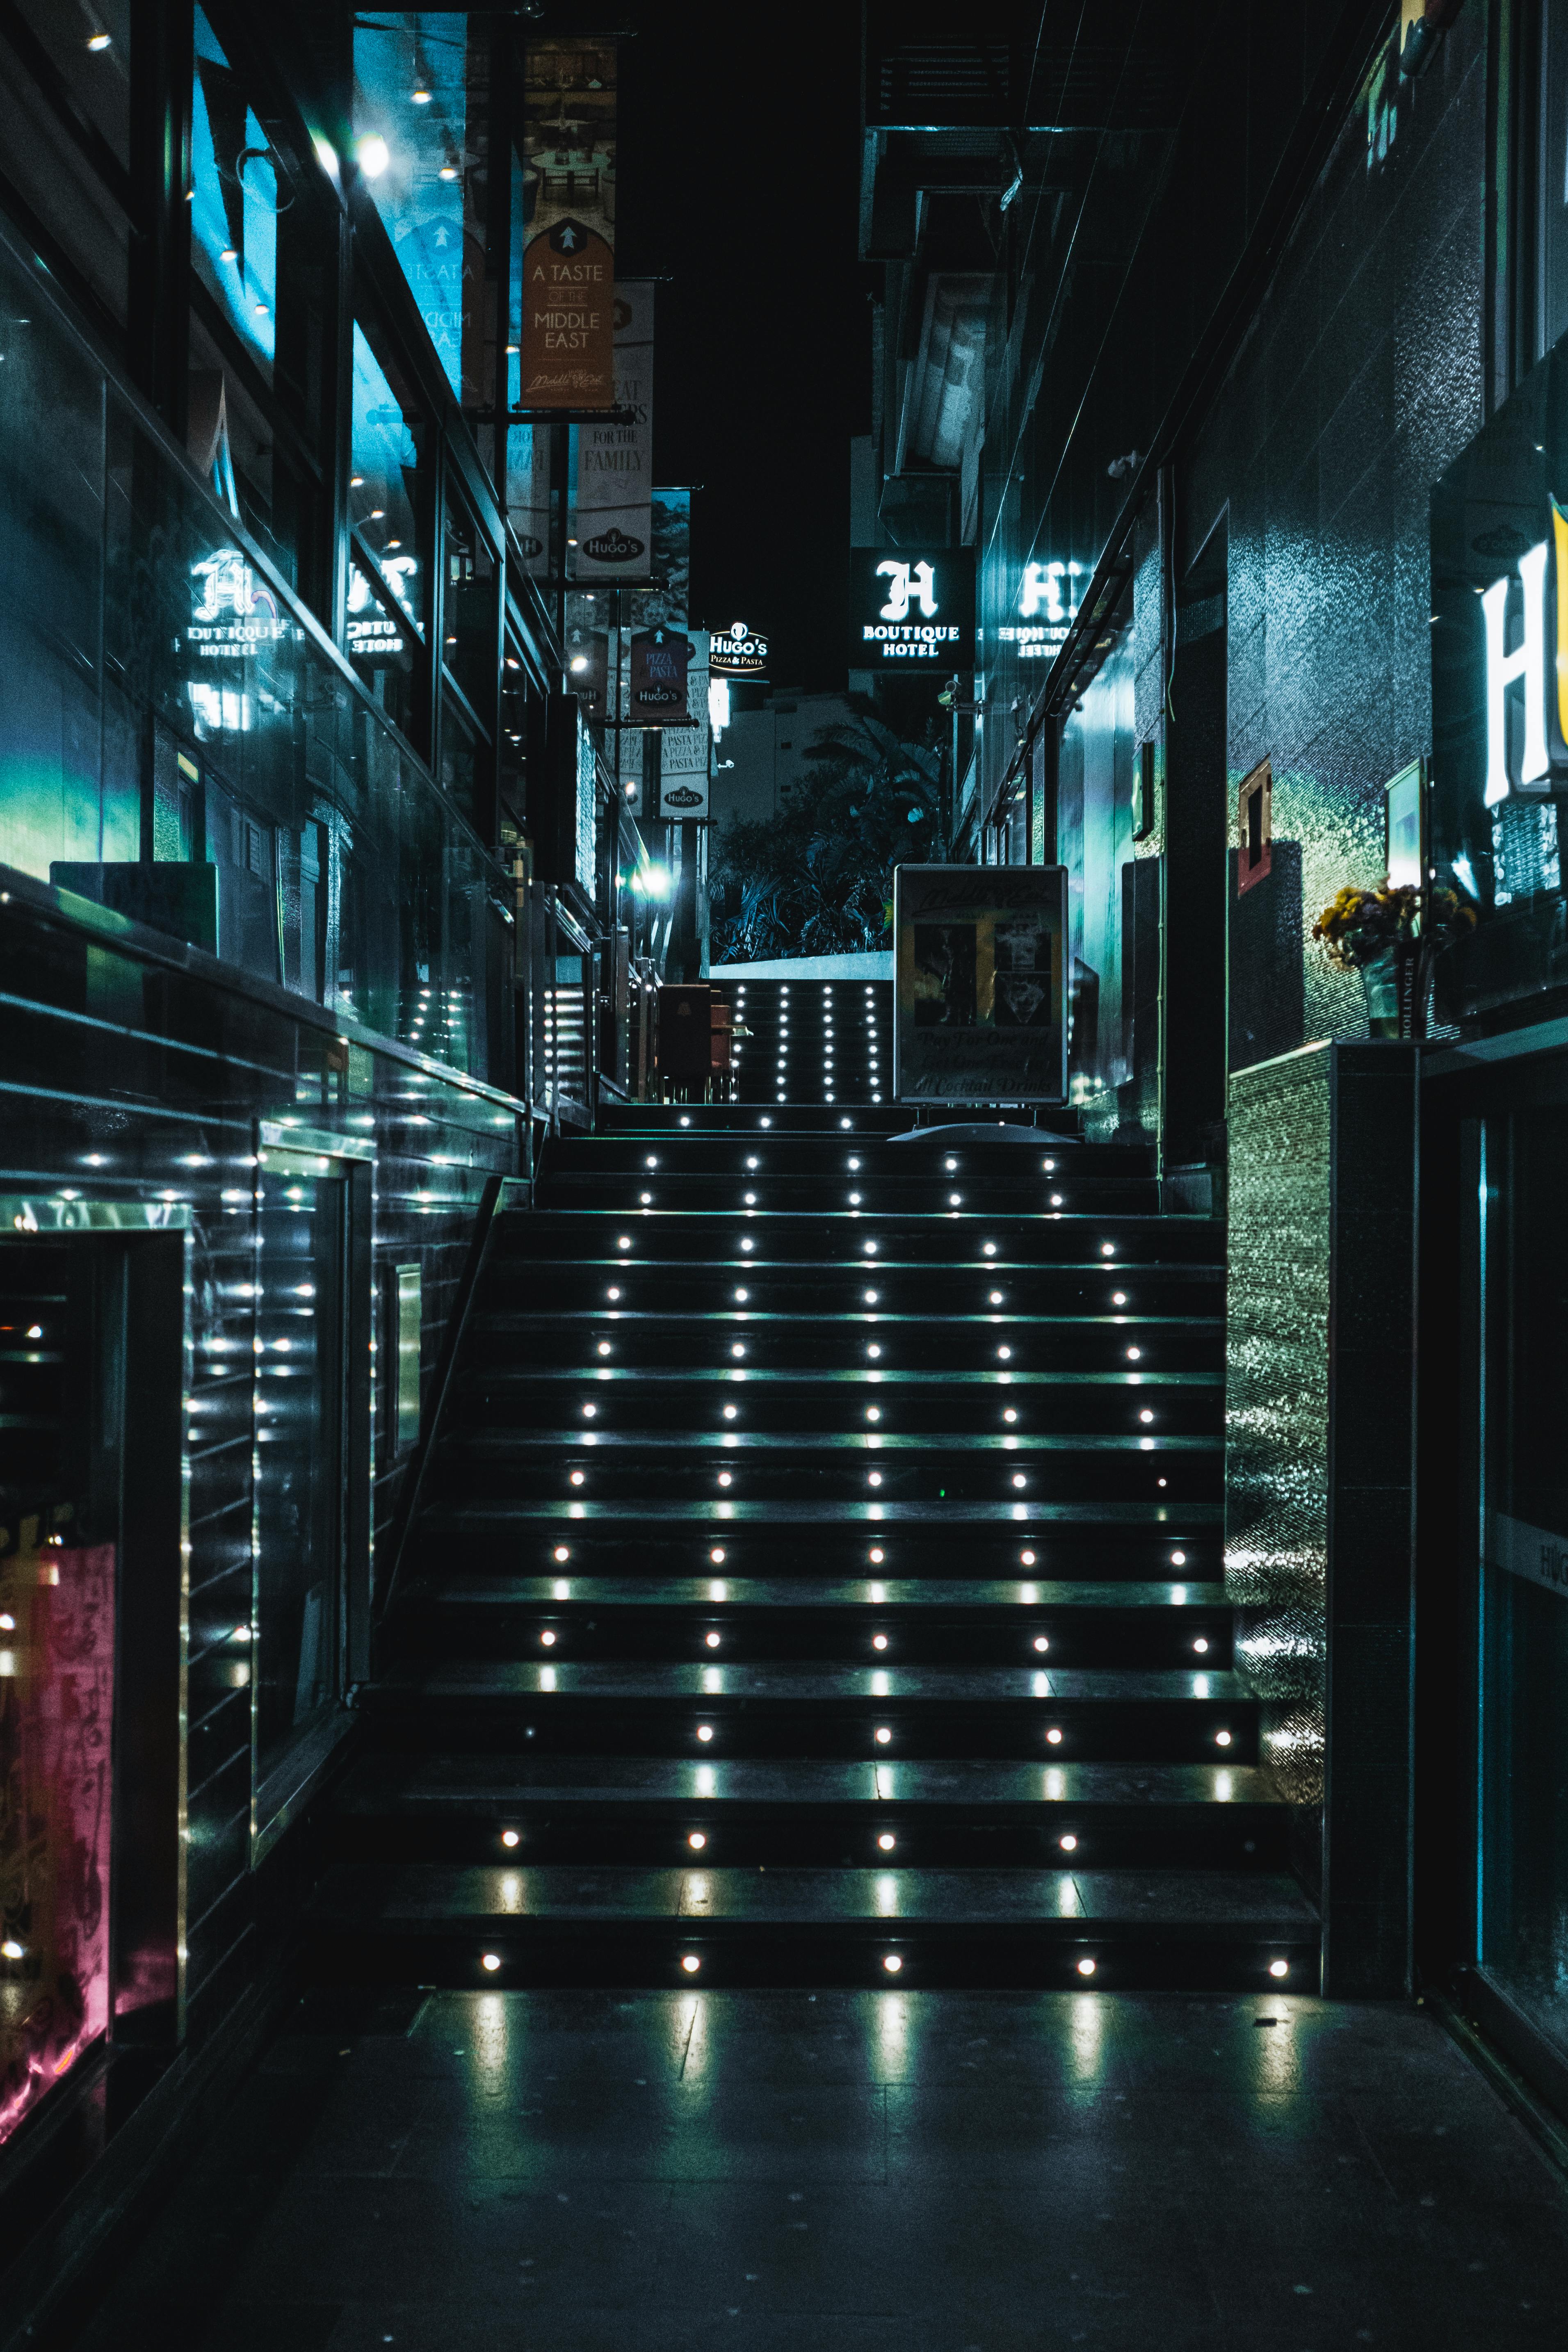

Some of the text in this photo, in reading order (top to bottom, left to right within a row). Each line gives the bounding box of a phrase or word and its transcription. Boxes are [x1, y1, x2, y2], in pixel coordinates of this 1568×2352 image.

[533, 265, 603, 281] A TASTE
[534, 313, 600, 329] MIDDLE
[545, 332, 589, 348] EAST
[526, 374, 570, 392] Middle
[593, 429, 638, 444] FOR THE
[584, 450, 642, 471] FAMILY
[863, 626, 959, 644] BOUTIQUE
[883, 643, 939, 657] HOTEL
[646, 652, 672, 665] PIZZA
[732, 656, 739, 665] &
[650, 665, 679, 678] PASTA
[668, 735, 692, 746] PASTA
[670, 758, 694, 769] PASTA
[1402, 957, 1415, 1039] BOLLINGER
[917, 1032, 950, 1051] Pay
[987, 1031, 1017, 1045] One
[1020, 1032, 1049, 1046] and
[935, 1077, 994, 1096] Cocktail
[997, 1077, 1052, 1093] Drinks
